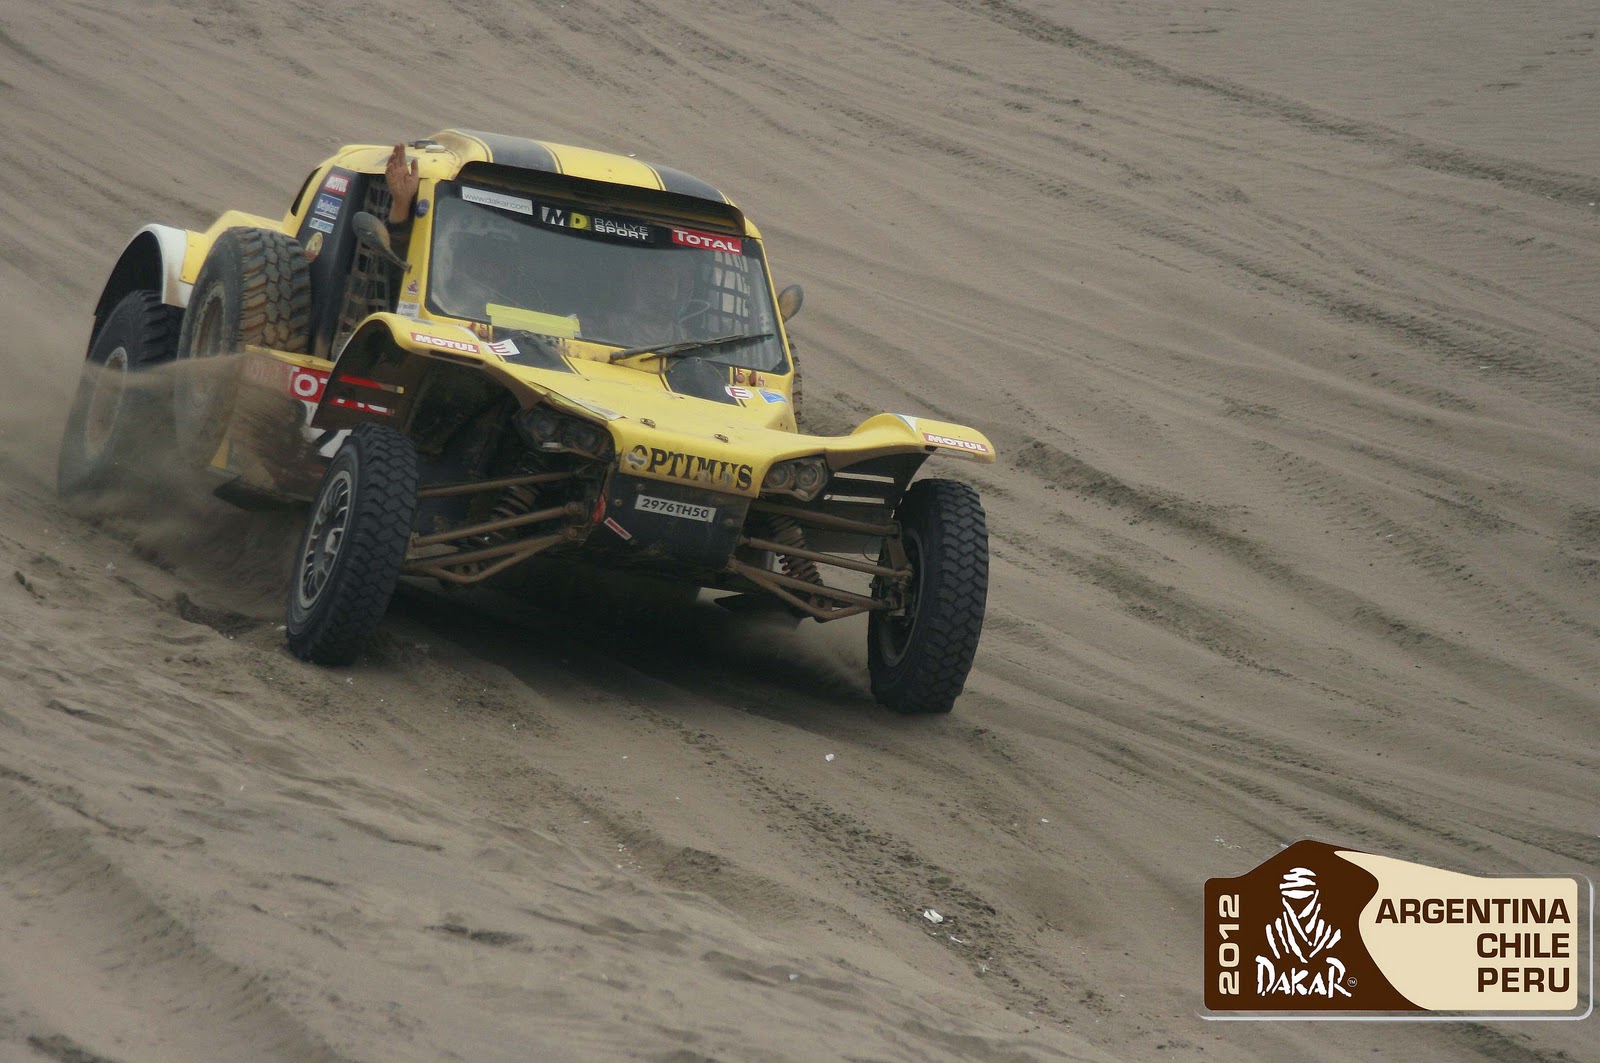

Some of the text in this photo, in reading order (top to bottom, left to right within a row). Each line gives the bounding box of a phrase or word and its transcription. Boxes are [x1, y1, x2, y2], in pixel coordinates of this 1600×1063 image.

[595, 218, 648, 232] RALLYE
[595, 225, 648, 240] SPORT
[674, 230, 740, 252] TOTAL
[415, 334, 478, 353] MOTUL
[928, 434, 986, 452] MOTUL
[629, 445, 753, 491] OPTIMUS
[642, 498, 709, 519] 2976TH50
